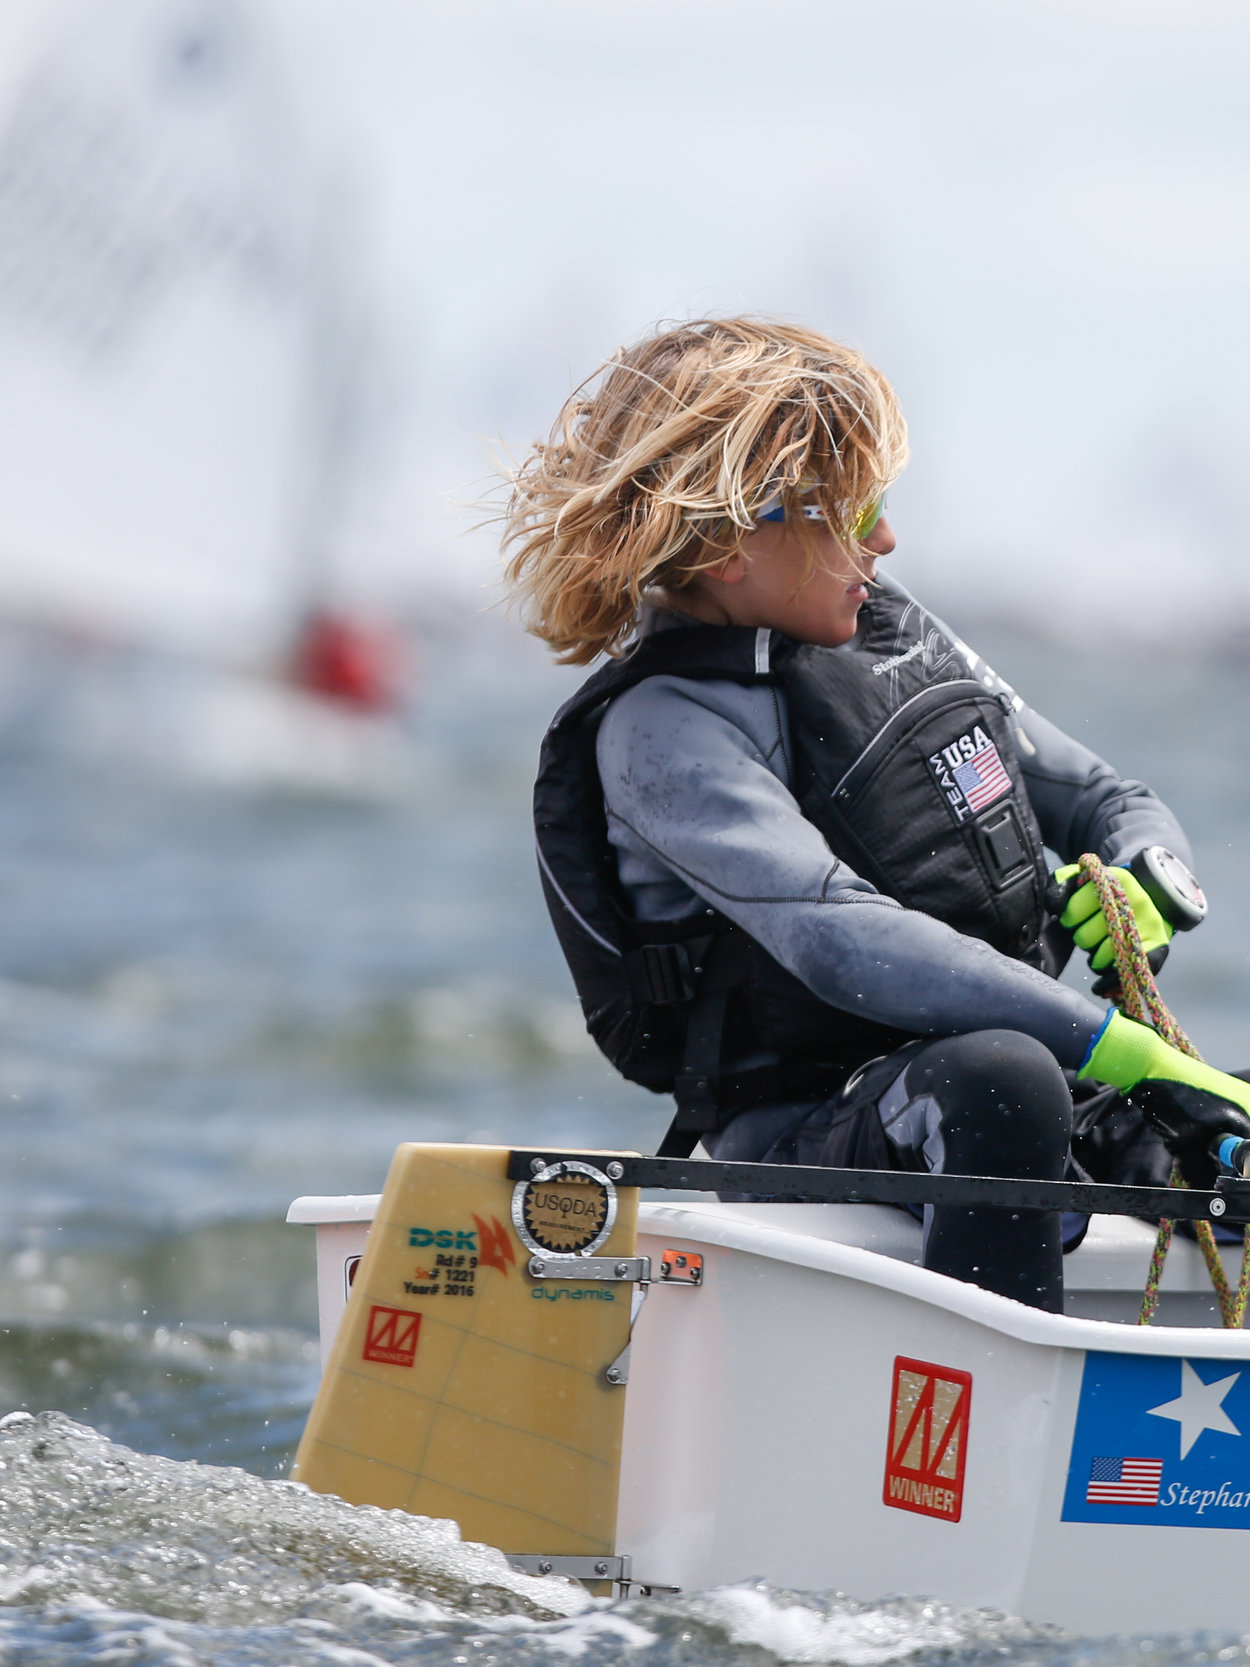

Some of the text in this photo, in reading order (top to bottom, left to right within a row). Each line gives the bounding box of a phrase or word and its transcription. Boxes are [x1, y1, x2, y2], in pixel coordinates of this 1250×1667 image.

[942, 725, 993, 768] USA
[929, 753, 969, 821] TEAM
[408, 1227, 478, 1251] DSK
[469, 1256, 478, 1268] 9
[446, 1270, 475, 1282] 1221
[444, 1284, 475, 1297] 2016
[531, 1286, 615, 1301] dynamis
[889, 1474, 955, 1514] WINNER
